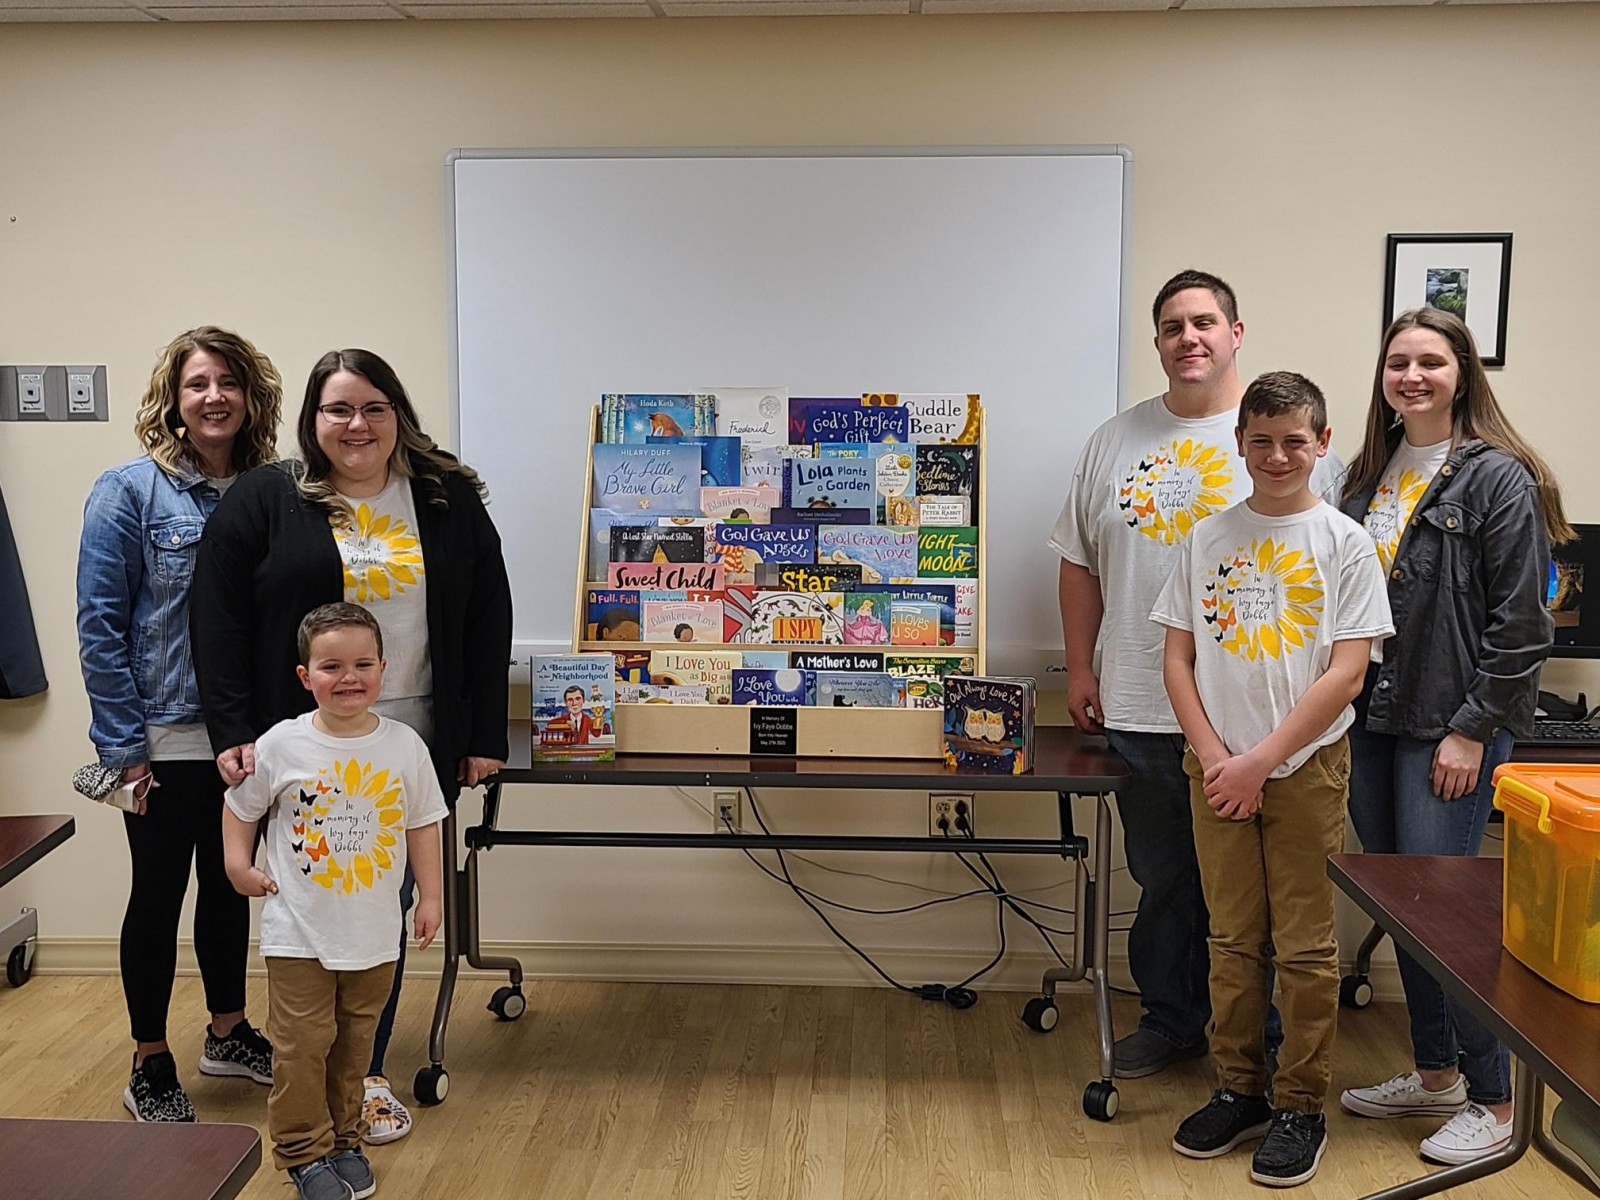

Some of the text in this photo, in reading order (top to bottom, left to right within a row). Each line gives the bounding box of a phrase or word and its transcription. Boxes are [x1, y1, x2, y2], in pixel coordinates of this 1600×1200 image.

[640, 399, 674, 408] Hoda Kotb
[903, 400, 961, 417] Cuddle
[729, 421, 776, 435] Frederick
[813, 410, 848, 433] God's
[854, 410, 903, 436] Perfect
[910, 418, 956, 434] Bear
[845, 429, 870, 444] Gift
[889, 456, 894, 464] 3
[613, 458, 674, 482] My Little
[744, 462, 781, 476] twir
[797, 462, 867, 486] Lola Plants
[603, 474, 686, 496] Brave Girl
[817, 478, 870, 492] a Garden
[1158, 480, 1183, 488] memory
[629, 531, 640, 540] Lost
[654, 532, 674, 540] Named
[722, 528, 747, 542] God
[751, 528, 788, 542] Gave
[823, 532, 850, 546] God
[853, 532, 888, 547] Gave
[763, 542, 809, 558] Angels
[874, 548, 912, 560] Love
[919, 556, 968, 572] MOON
[615, 566, 717, 590] Sweet Child
[782, 569, 838, 592] Star
[902, 590, 924, 600] LITTLE
[956, 584, 976, 594] GIVE
[1236, 583, 1278, 597] memory of
[651, 610, 686, 627] Blanket
[697, 612, 718, 627] Love
[1242, 608, 1268, 620] Dobbs
[779, 618, 816, 639] I SPY
[904, 628, 920, 640] SO
[536, 663, 610, 673] A Beautiful Day
[666, 656, 670, 668] I
[675, 656, 705, 670] Love
[708, 658, 730, 670] You
[796, 656, 878, 669] A Mother's Love
[550, 672, 608, 682] Neighborhood
[700, 671, 718, 683] Big
[887, 664, 936, 678] BLAZE
[744, 676, 774, 693] Love
[758, 691, 785, 704] You
[949, 680, 1020, 708] Owl Always Love You
[762, 722, 776, 731] Faye
[776, 722, 793, 730] Dobbs
[326, 811, 373, 826] memory of
[334, 840, 362, 853] Dobbs
